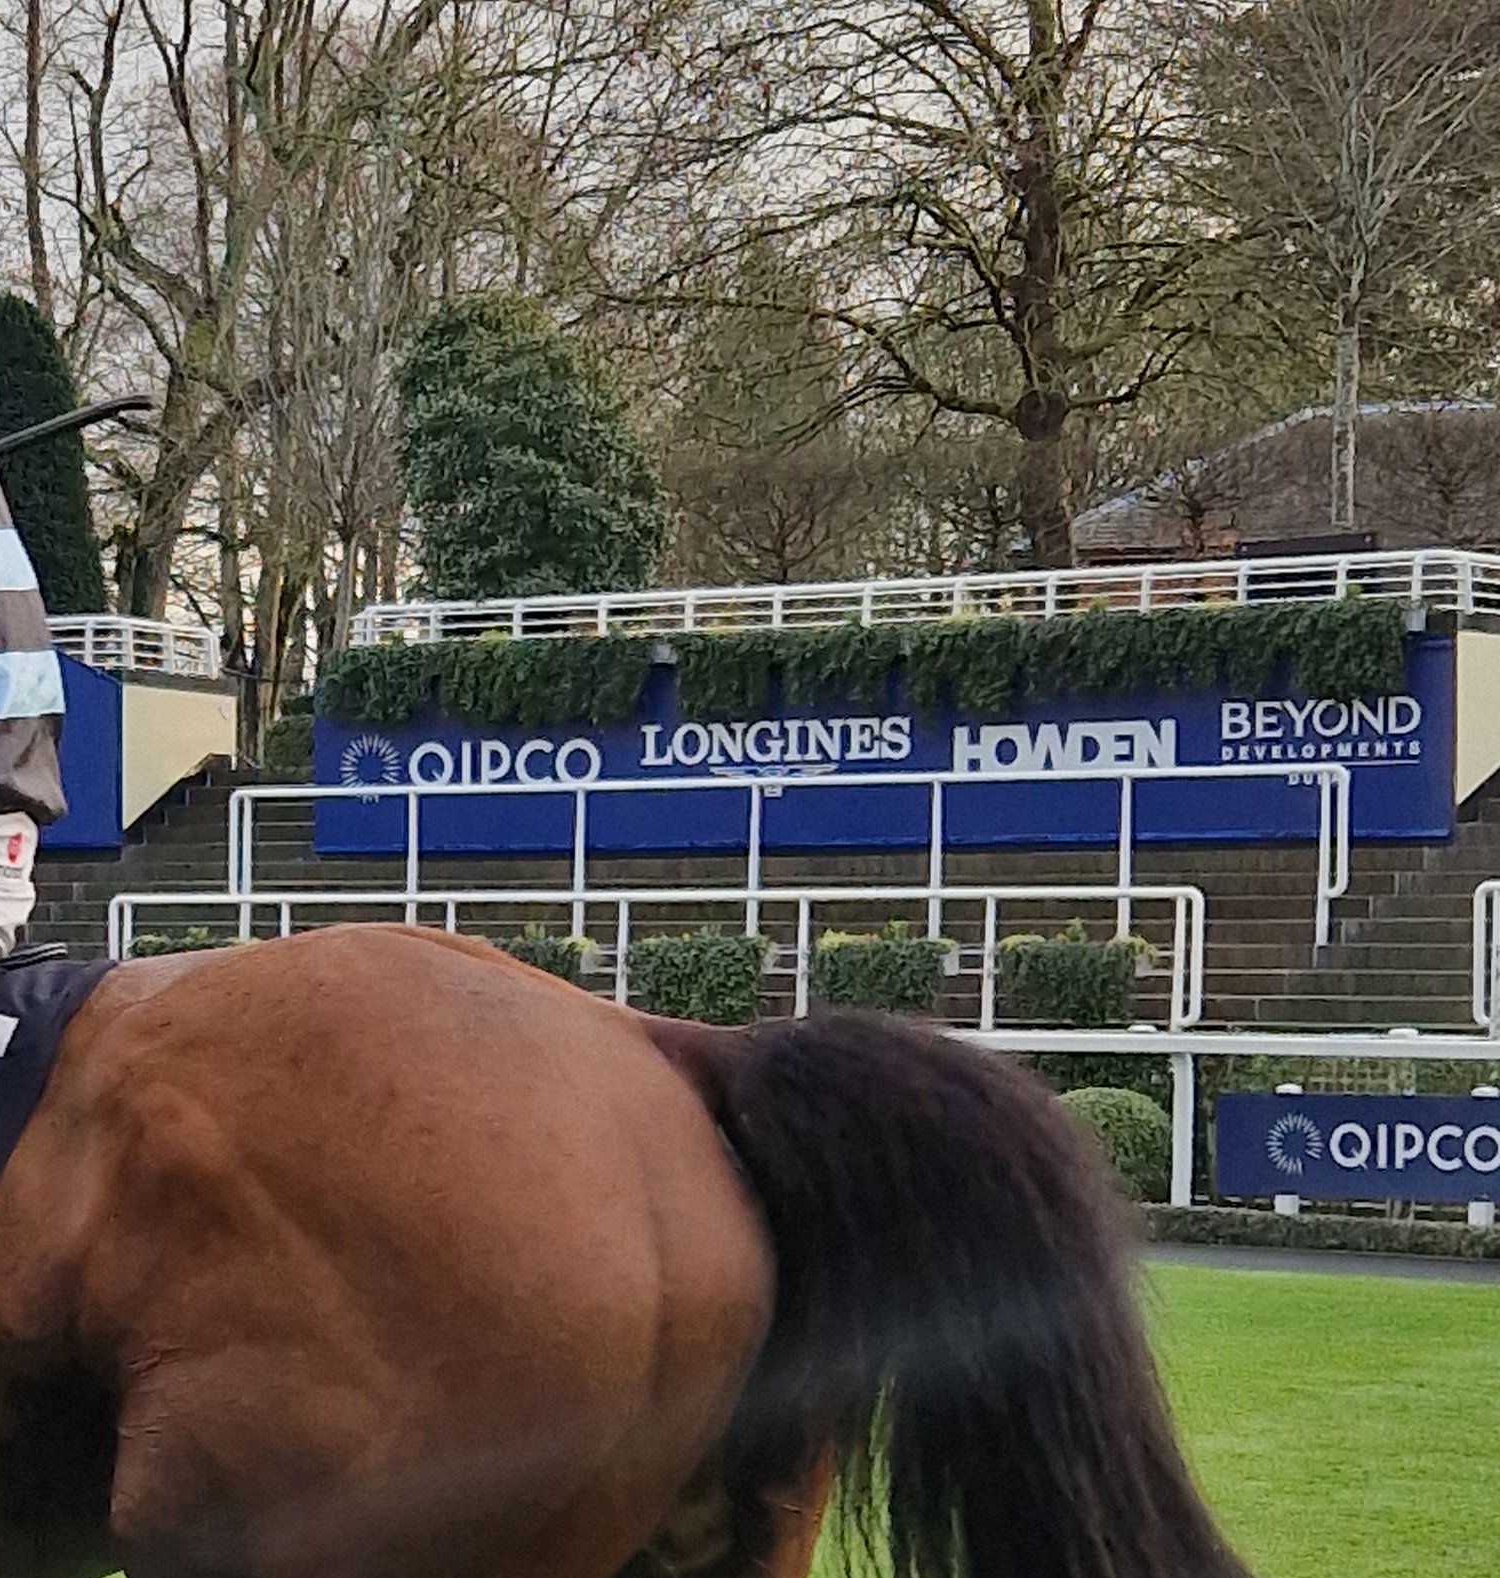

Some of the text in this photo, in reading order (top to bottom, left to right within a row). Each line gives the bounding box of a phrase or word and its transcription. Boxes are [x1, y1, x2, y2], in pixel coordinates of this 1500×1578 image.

[640, 716, 912, 767] LONGINES
[1221, 696, 1422, 740] BEYOND
[408, 737, 601, 786] QIPCO
[952, 717, 1177, 773] HOWDEN
[1221, 741, 1422, 761] DEVELOPMENTS
[1329, 1122, 1500, 1173] QIPCO
